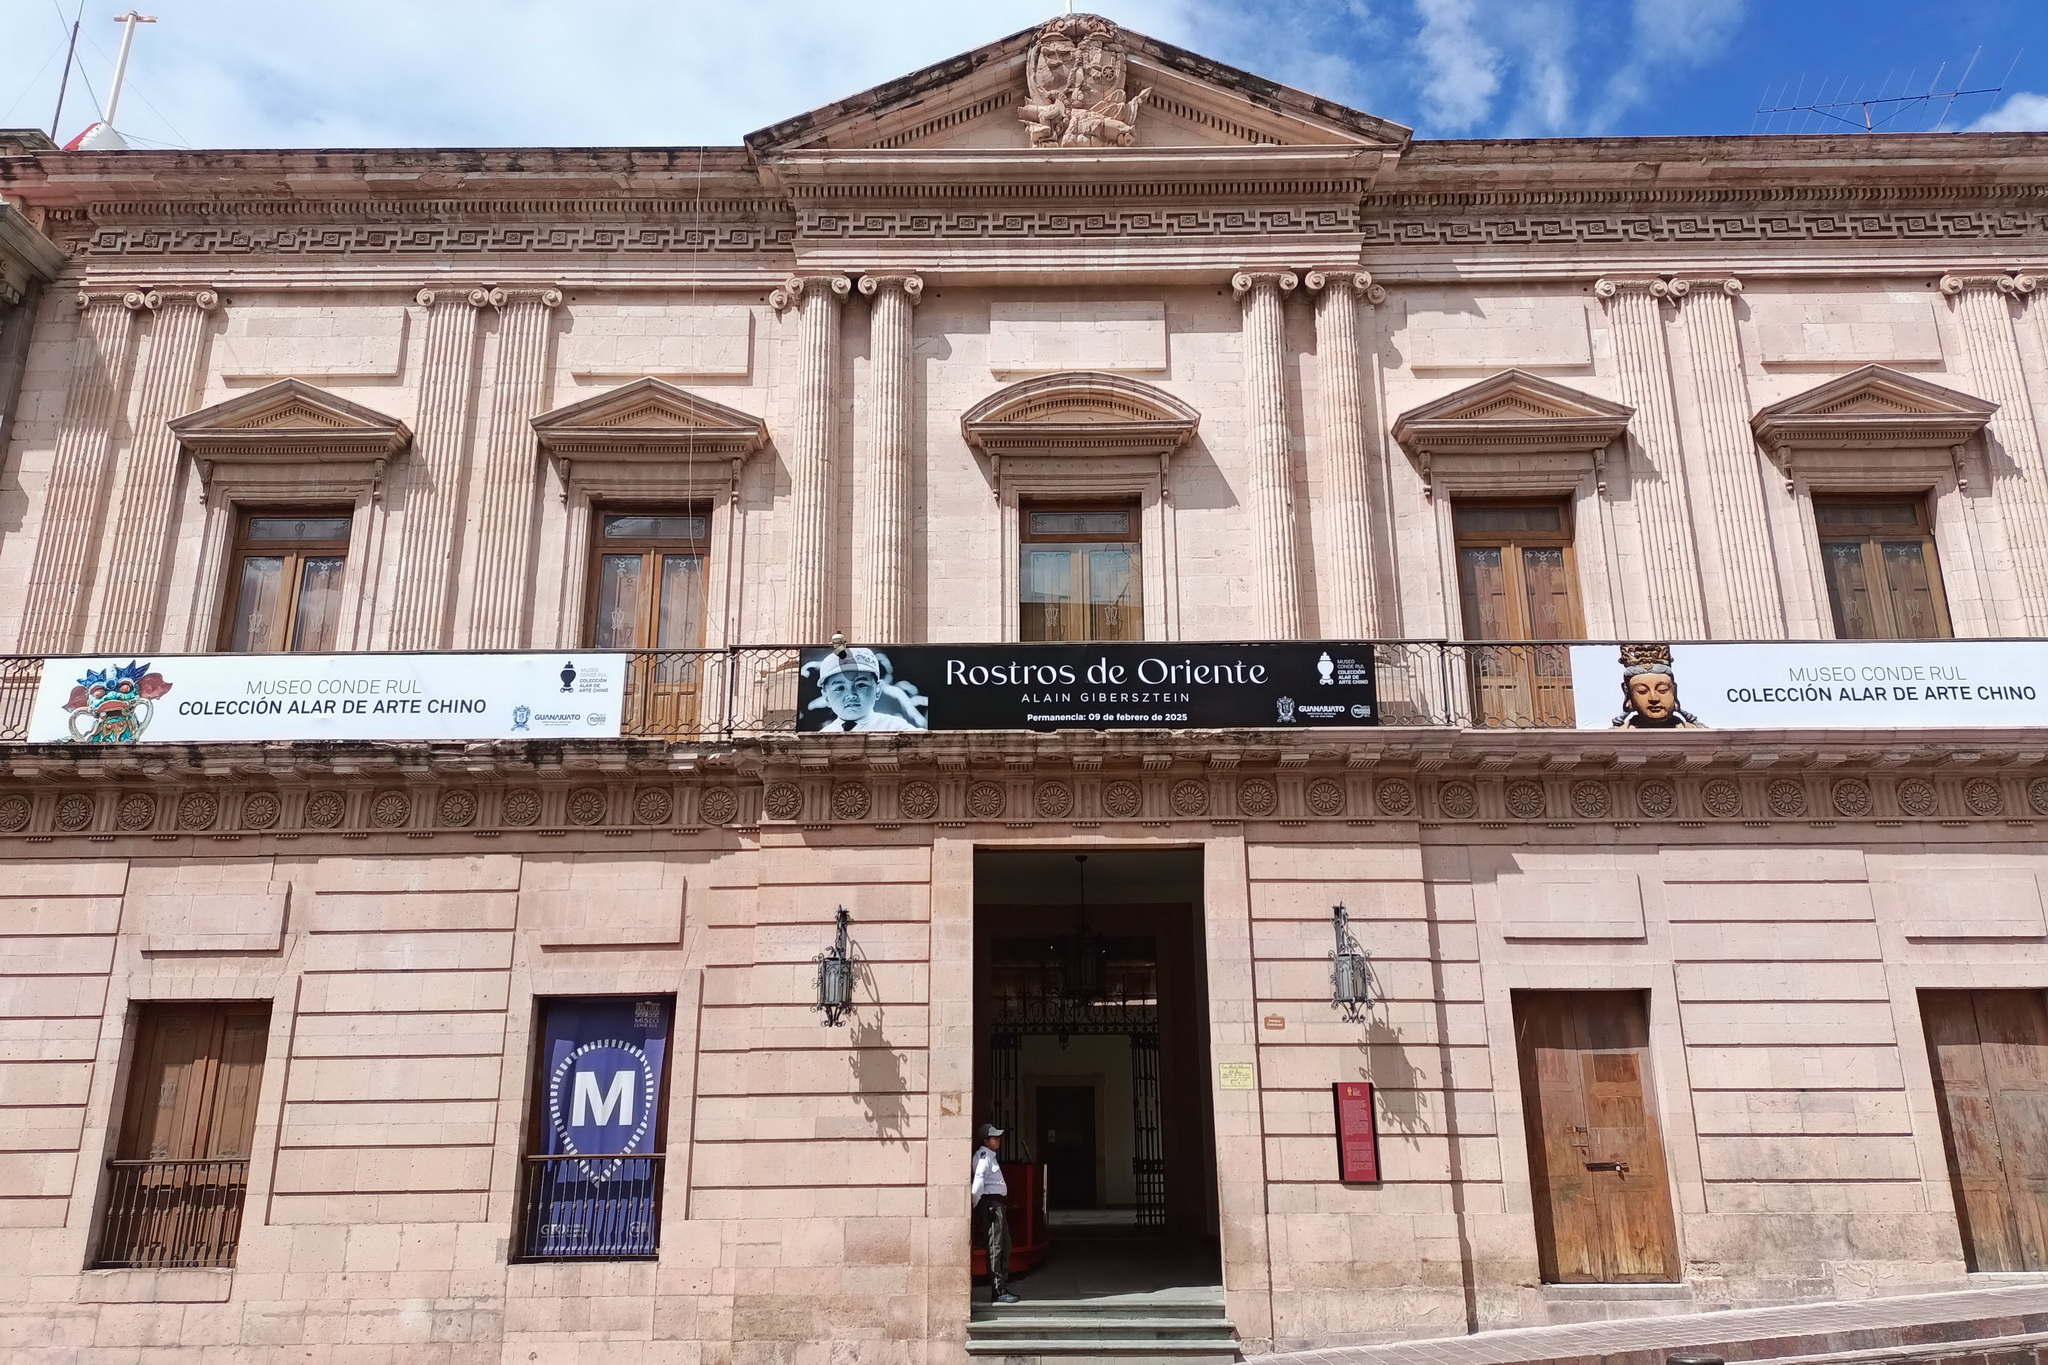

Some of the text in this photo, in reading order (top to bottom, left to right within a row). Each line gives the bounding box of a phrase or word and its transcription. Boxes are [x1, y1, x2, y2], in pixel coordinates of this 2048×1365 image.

[946, 657, 1269, 686] Rostros de Oriente
[1789, 666, 1967, 682] MUSEO CONDE RUL
[246, 679, 422, 695] MUSEO CONDE RUL
[1726, 683, 2037, 703] COLECCIÓN ALAR DE ARTE CHINO
[1021, 692, 1190, 703] ALAIN GIBERSZTEIN
[178, 696, 487, 716] COLECCIÓN ALAR DE ARTE CHINO
[1298, 705, 1346, 713] GUANAJUATO
[534, 713, 581, 721] GUANAJUATO
[1027, 713, 1188, 722] Permanencia: 09 de febrero de 2025
[571, 1070, 636, 1127] M
